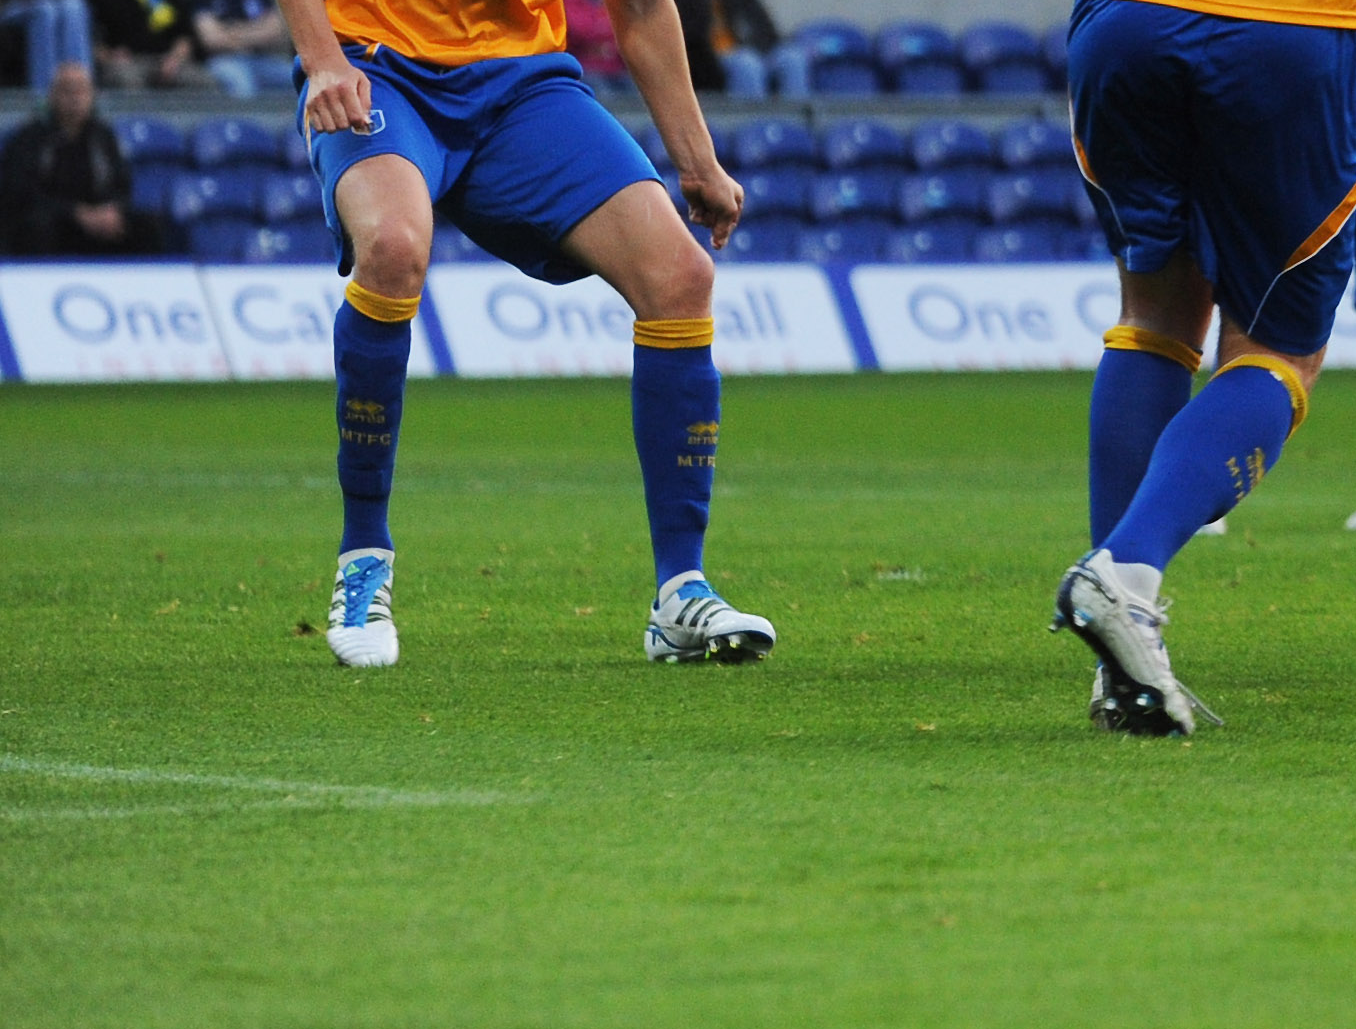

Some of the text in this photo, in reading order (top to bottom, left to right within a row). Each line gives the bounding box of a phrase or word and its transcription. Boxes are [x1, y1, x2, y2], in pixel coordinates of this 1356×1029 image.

[51, 282, 206, 345] One
[484, 280, 786, 341] One all
[908, 283, 1054, 342] One
